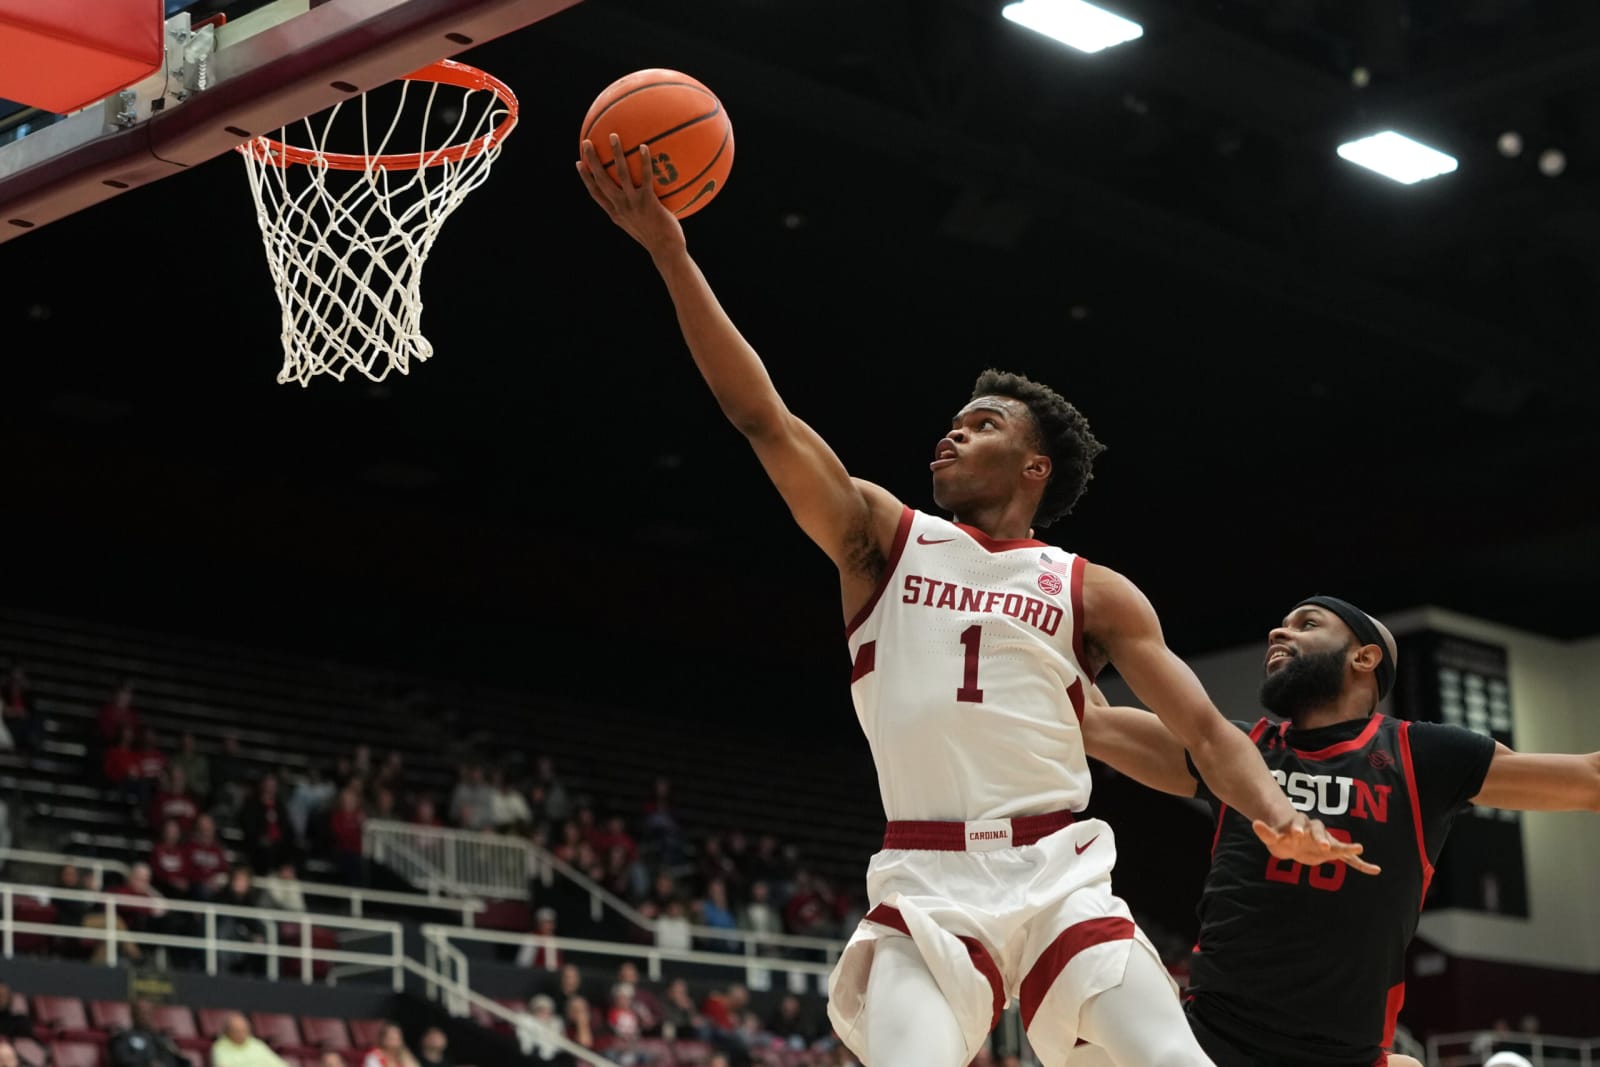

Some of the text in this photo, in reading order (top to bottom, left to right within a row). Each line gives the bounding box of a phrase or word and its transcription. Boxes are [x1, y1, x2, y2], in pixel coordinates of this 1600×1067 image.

[903, 575, 1063, 636] STANFORD
[957, 625, 983, 703] 1
[969, 830, 1008, 841] CARDINAL
